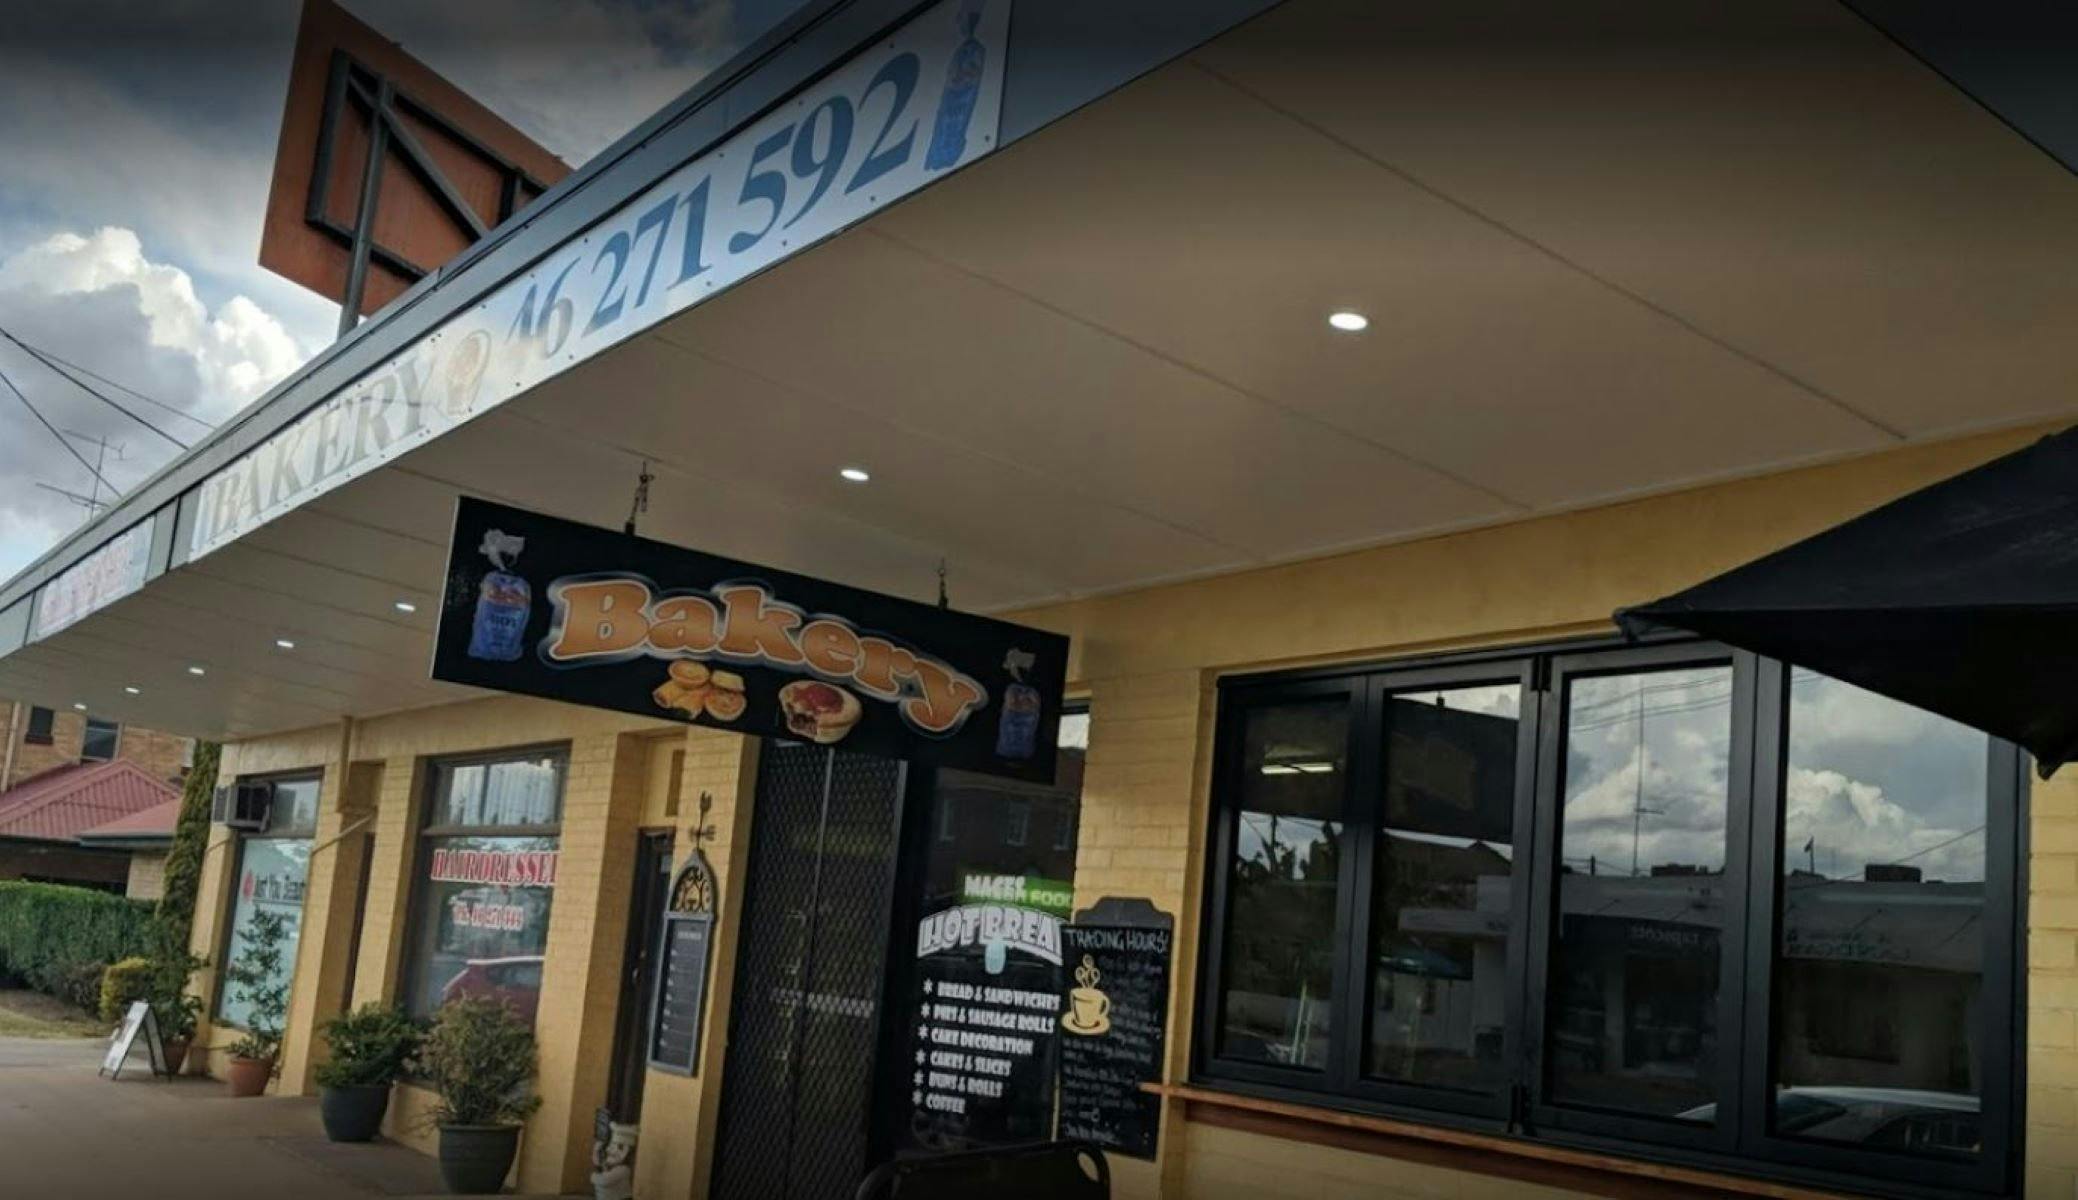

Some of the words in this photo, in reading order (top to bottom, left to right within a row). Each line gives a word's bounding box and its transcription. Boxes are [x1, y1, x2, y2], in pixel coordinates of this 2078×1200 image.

[209, 352, 440, 537] BAKERY
[728, 52, 921, 254] 592
[549, 577, 983, 731] Bakery
[918, 908, 980, 958] HOT
